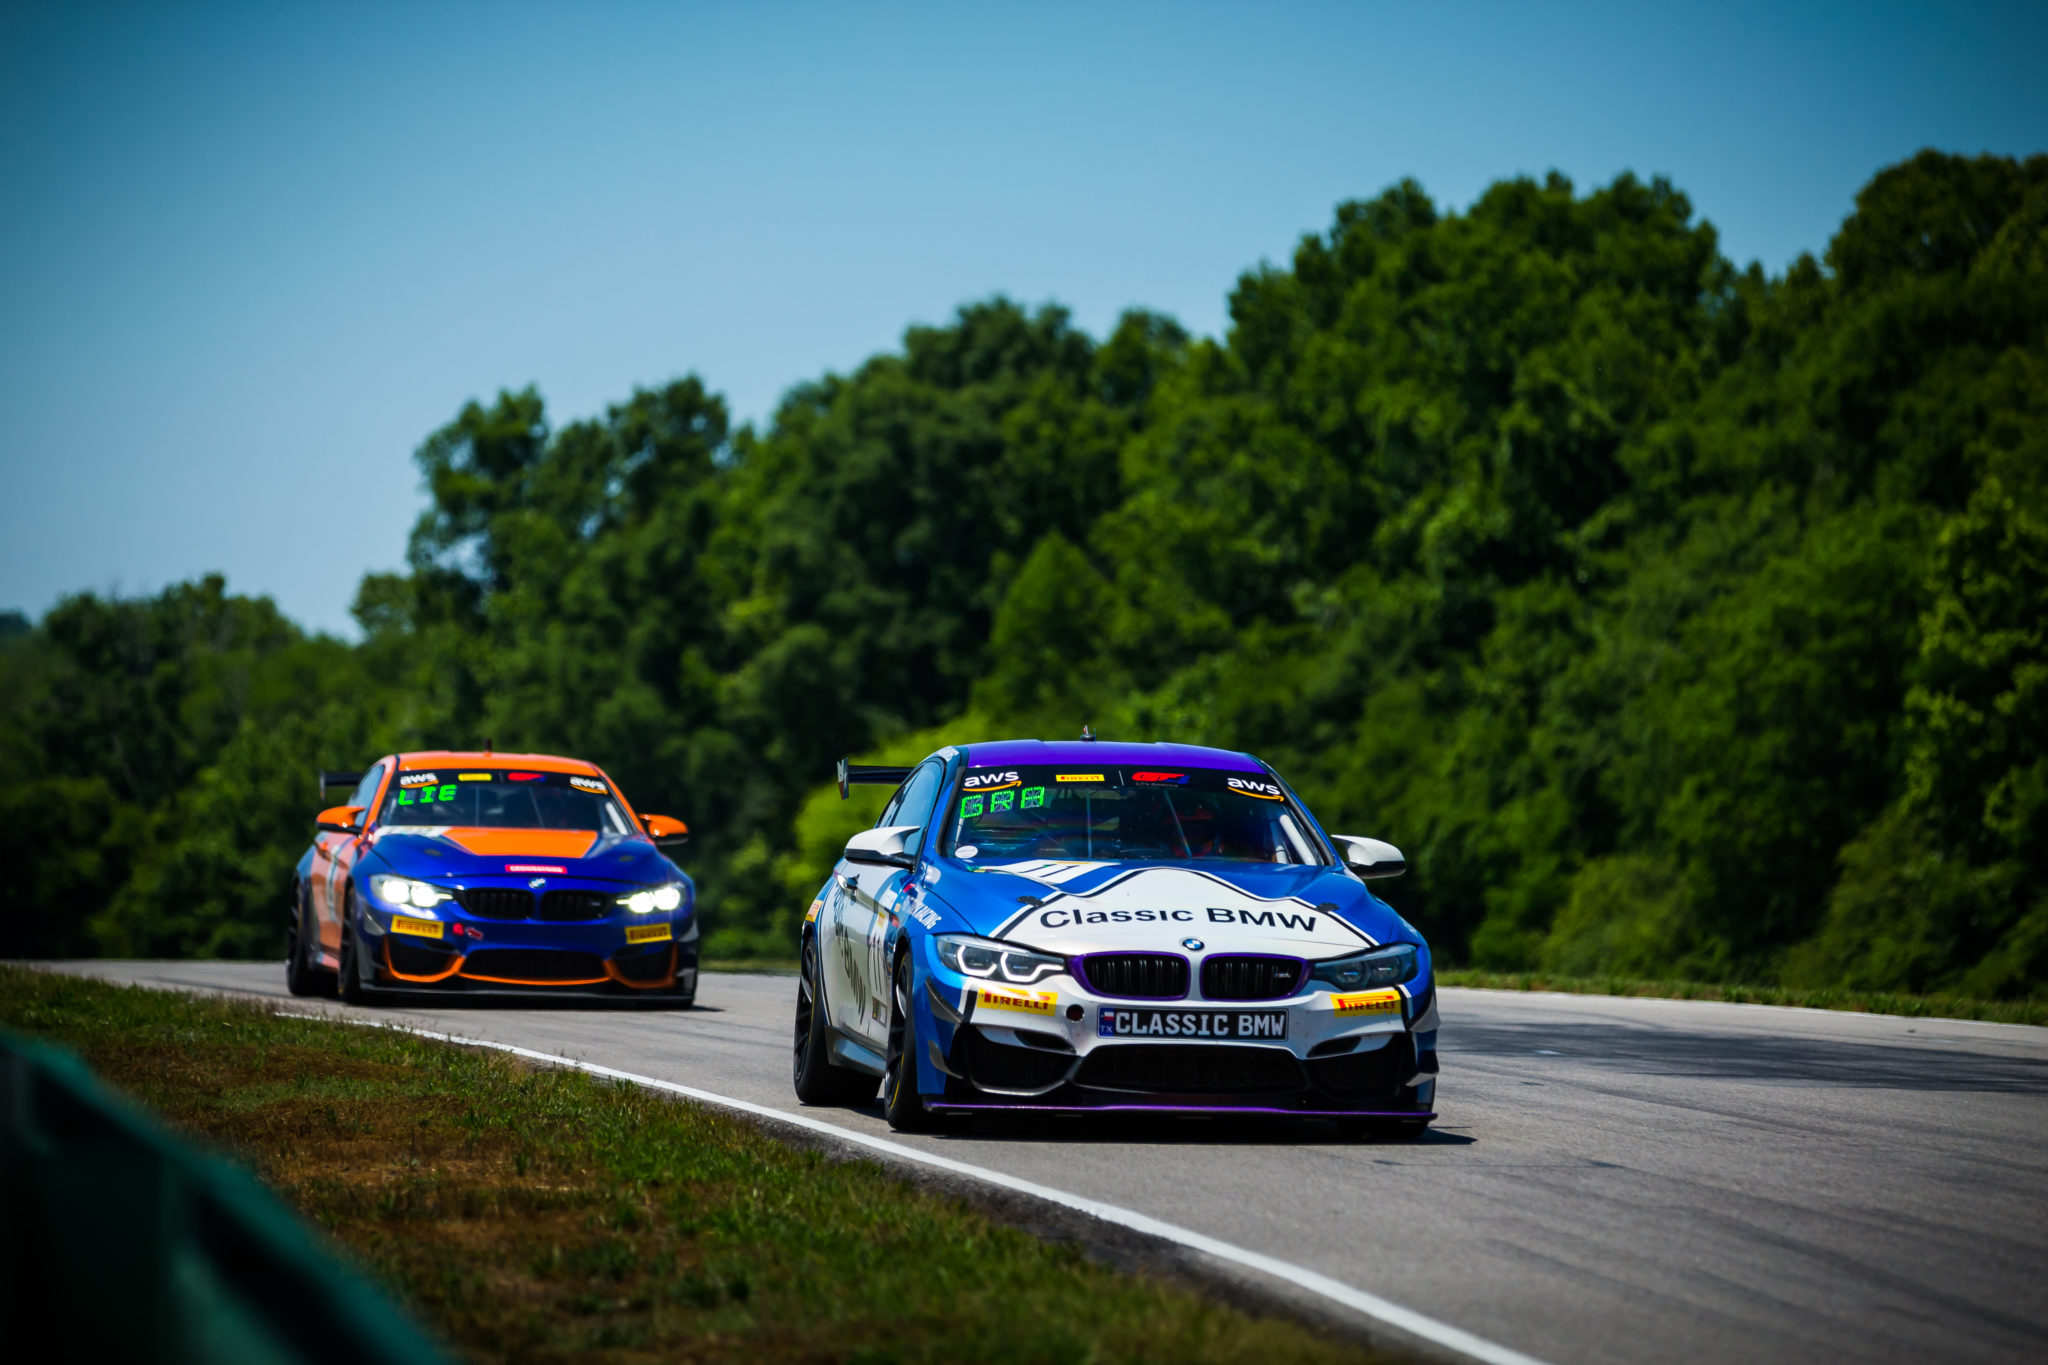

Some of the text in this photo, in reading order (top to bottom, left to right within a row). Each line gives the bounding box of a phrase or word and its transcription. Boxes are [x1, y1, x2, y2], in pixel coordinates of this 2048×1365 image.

[400, 772, 438, 786] aws
[569, 776, 607, 791] aws
[963, 771, 1020, 788] aws
[1227, 777, 1281, 796] aws
[398, 784, 457, 806] LIE
[1039, 907, 1317, 933] Classic BMW
[983, 991, 1050, 1011] PIRELLI
[1337, 994, 1396, 1012] PIRELLI
[1114, 1011, 1286, 1037] CLASSIC BMW
